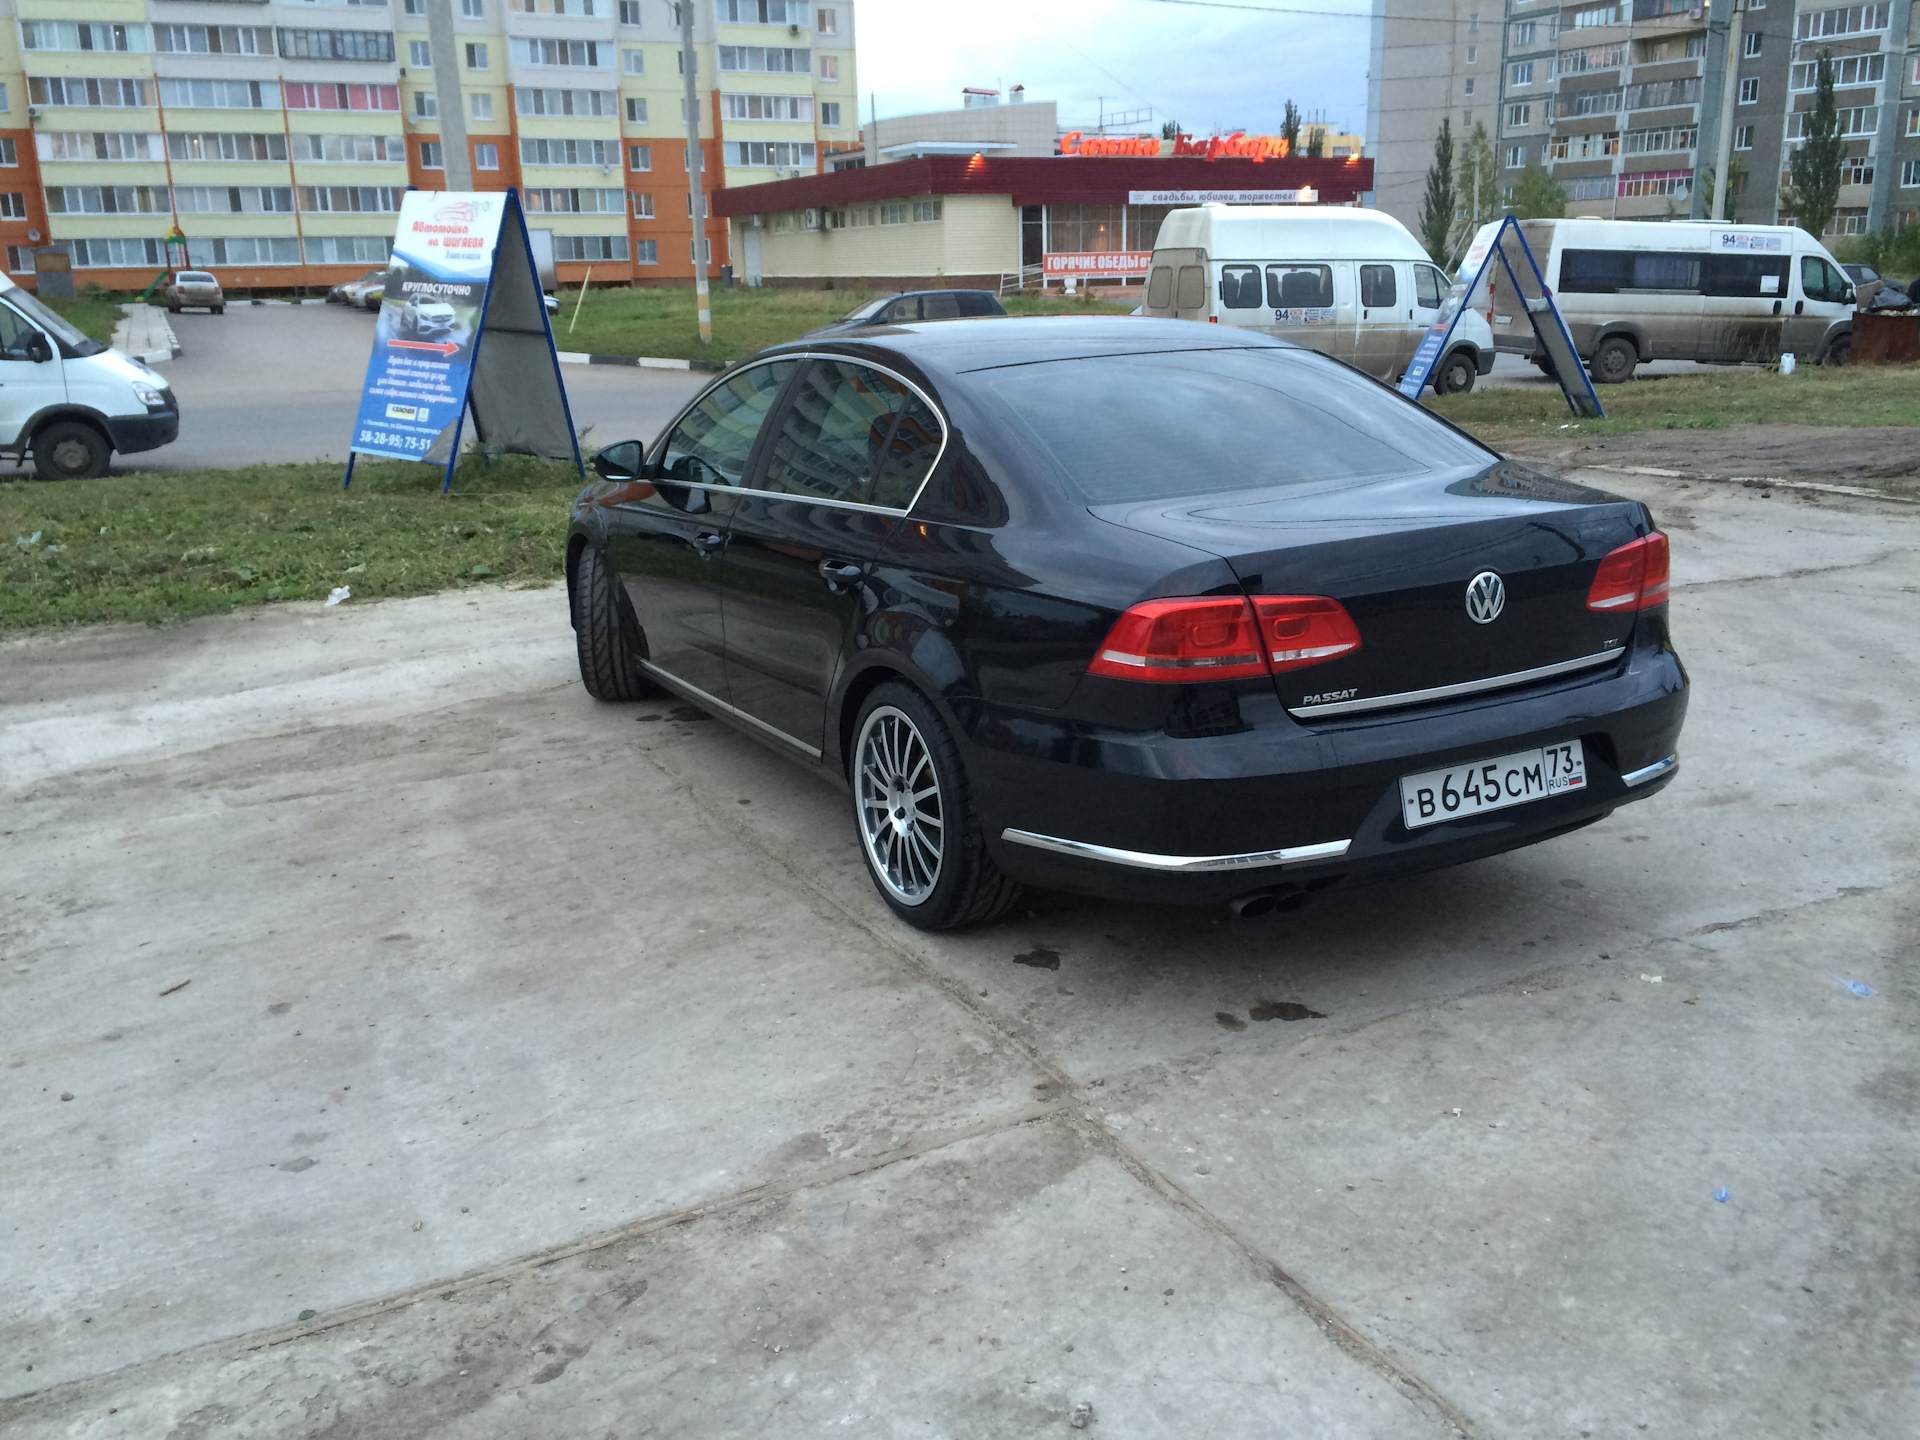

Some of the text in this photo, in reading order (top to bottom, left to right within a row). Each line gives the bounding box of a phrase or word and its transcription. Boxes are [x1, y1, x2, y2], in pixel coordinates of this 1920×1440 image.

[1060, 131, 1289, 163] Санта Барбара
[1152, 191, 1196, 203] свадьбы,
[1239, 191, 1296, 203] торжества!
[443, 237, 484, 248] ШИГАЕВА
[1722, 234, 1736, 244] 94
[1047, 255, 1096, 270] ГОРЯЧИЕ
[1097, 255, 1138, 270] ОБЕДЫ
[402, 281, 471, 296] КРУГЛОСУТОЧНО
[1275, 309, 1289, 320] 94
[1302, 688, 1358, 705] PASSAT
[1546, 745, 1574, 778] 73
[1548, 776, 1569, 790] RUS
